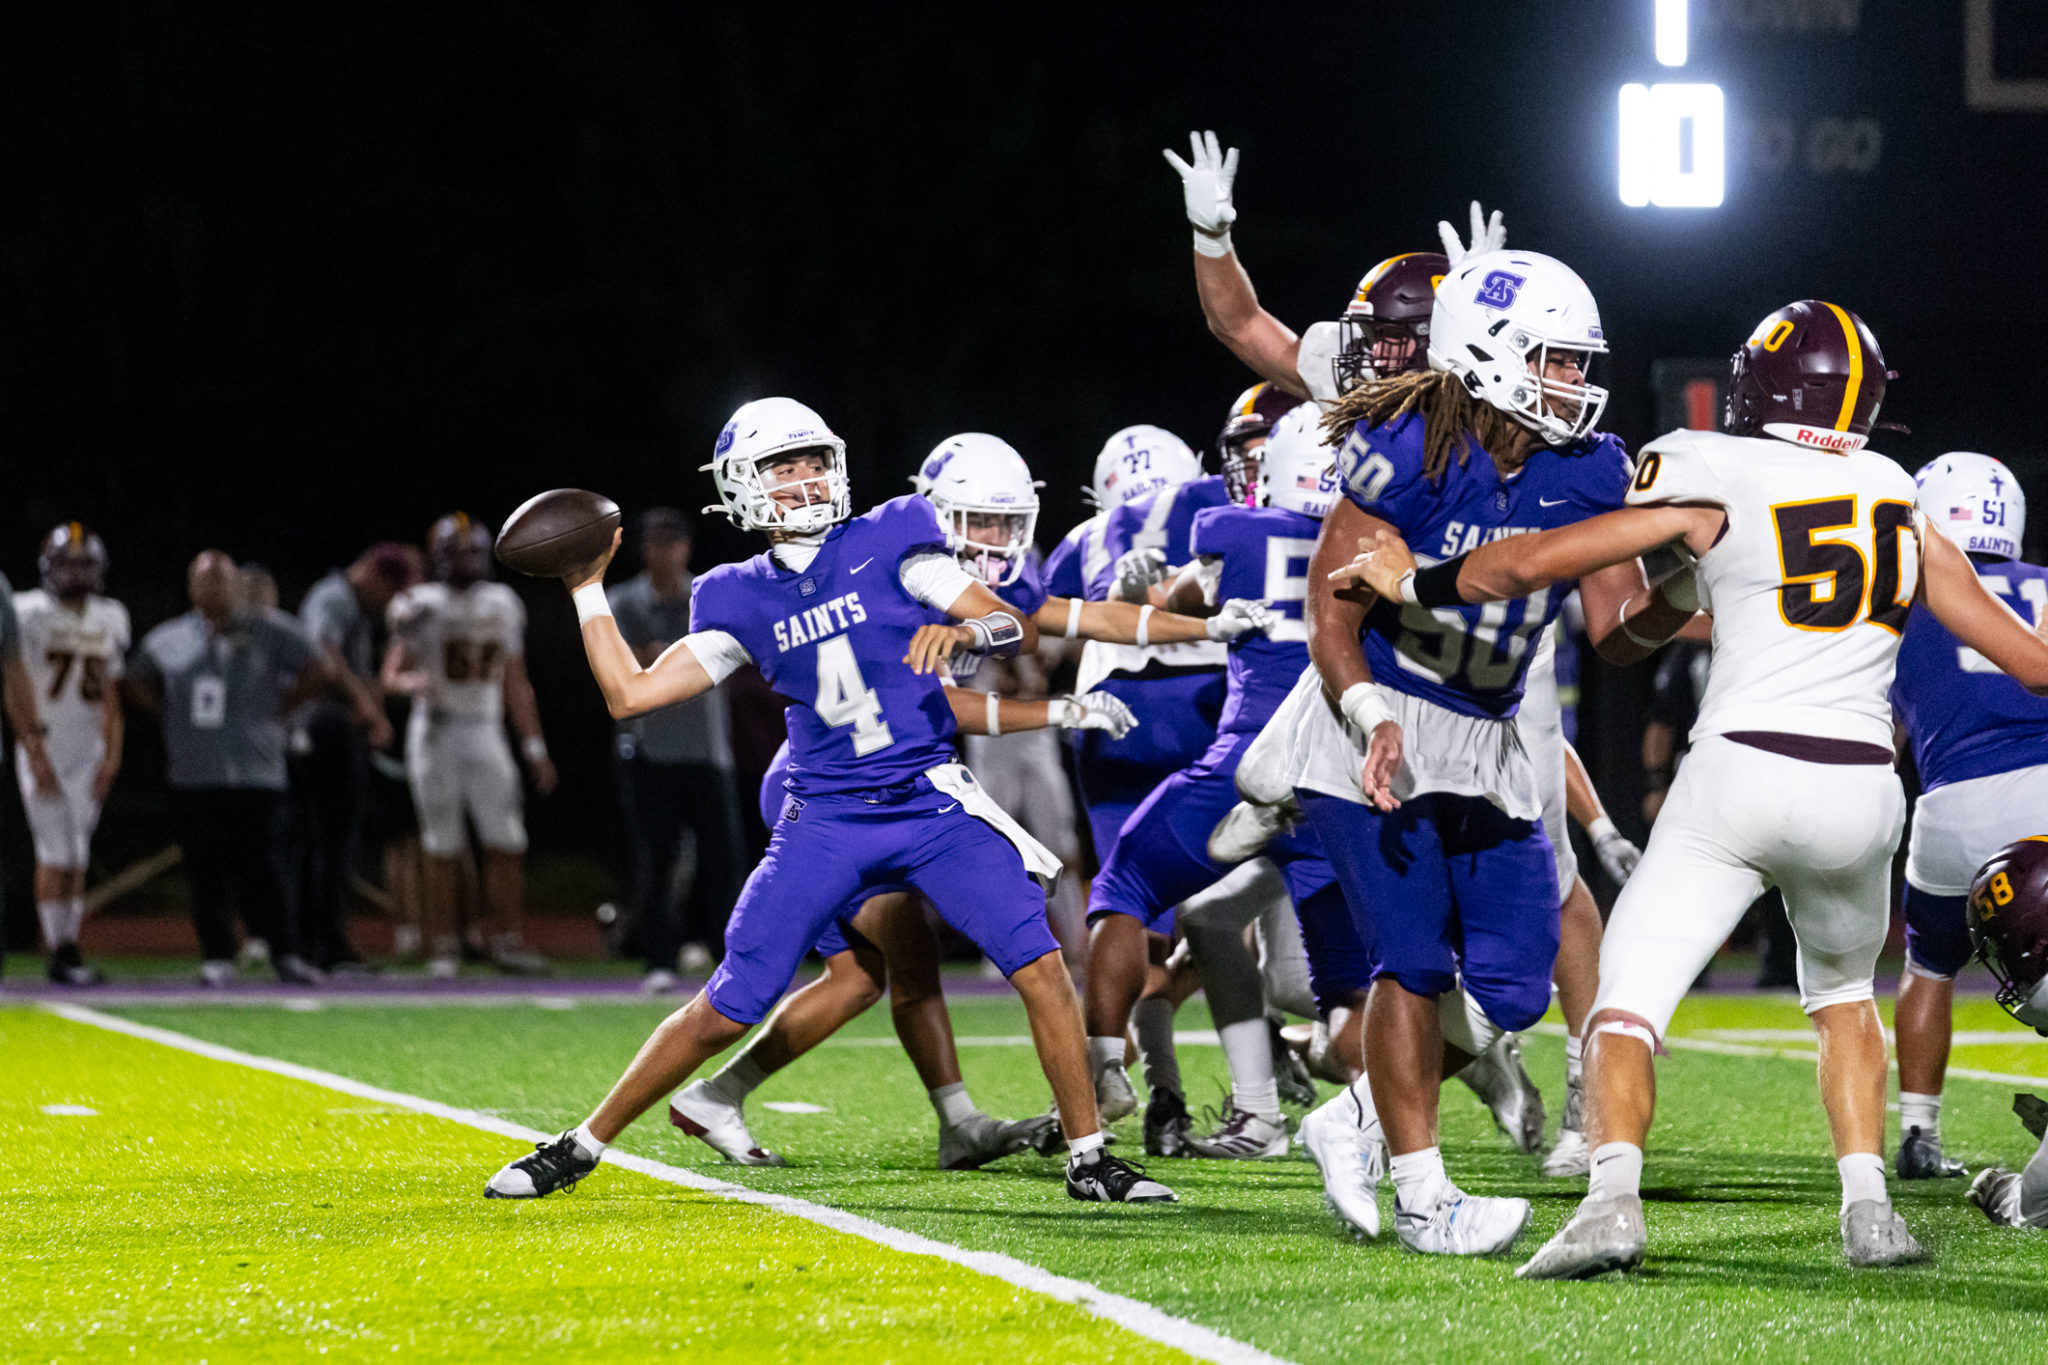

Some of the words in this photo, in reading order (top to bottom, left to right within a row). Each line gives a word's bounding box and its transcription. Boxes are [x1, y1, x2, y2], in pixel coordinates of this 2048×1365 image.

[1619, 83, 1724, 207] 10
[788, 430, 814, 439] FAMIY
[1797, 429, 1862, 450] Riddell
[1123, 450, 1151, 474] 77
[1339, 430, 1395, 502] 50
[1633, 451, 1662, 492] 0
[1983, 501, 2006, 527] 51
[1769, 493, 1920, 637] 50
[1969, 536, 2015, 555] SAINTS
[773, 592, 867, 653] SAINTS
[815, 633, 895, 757] 4
[1974, 871, 2014, 921] 58
